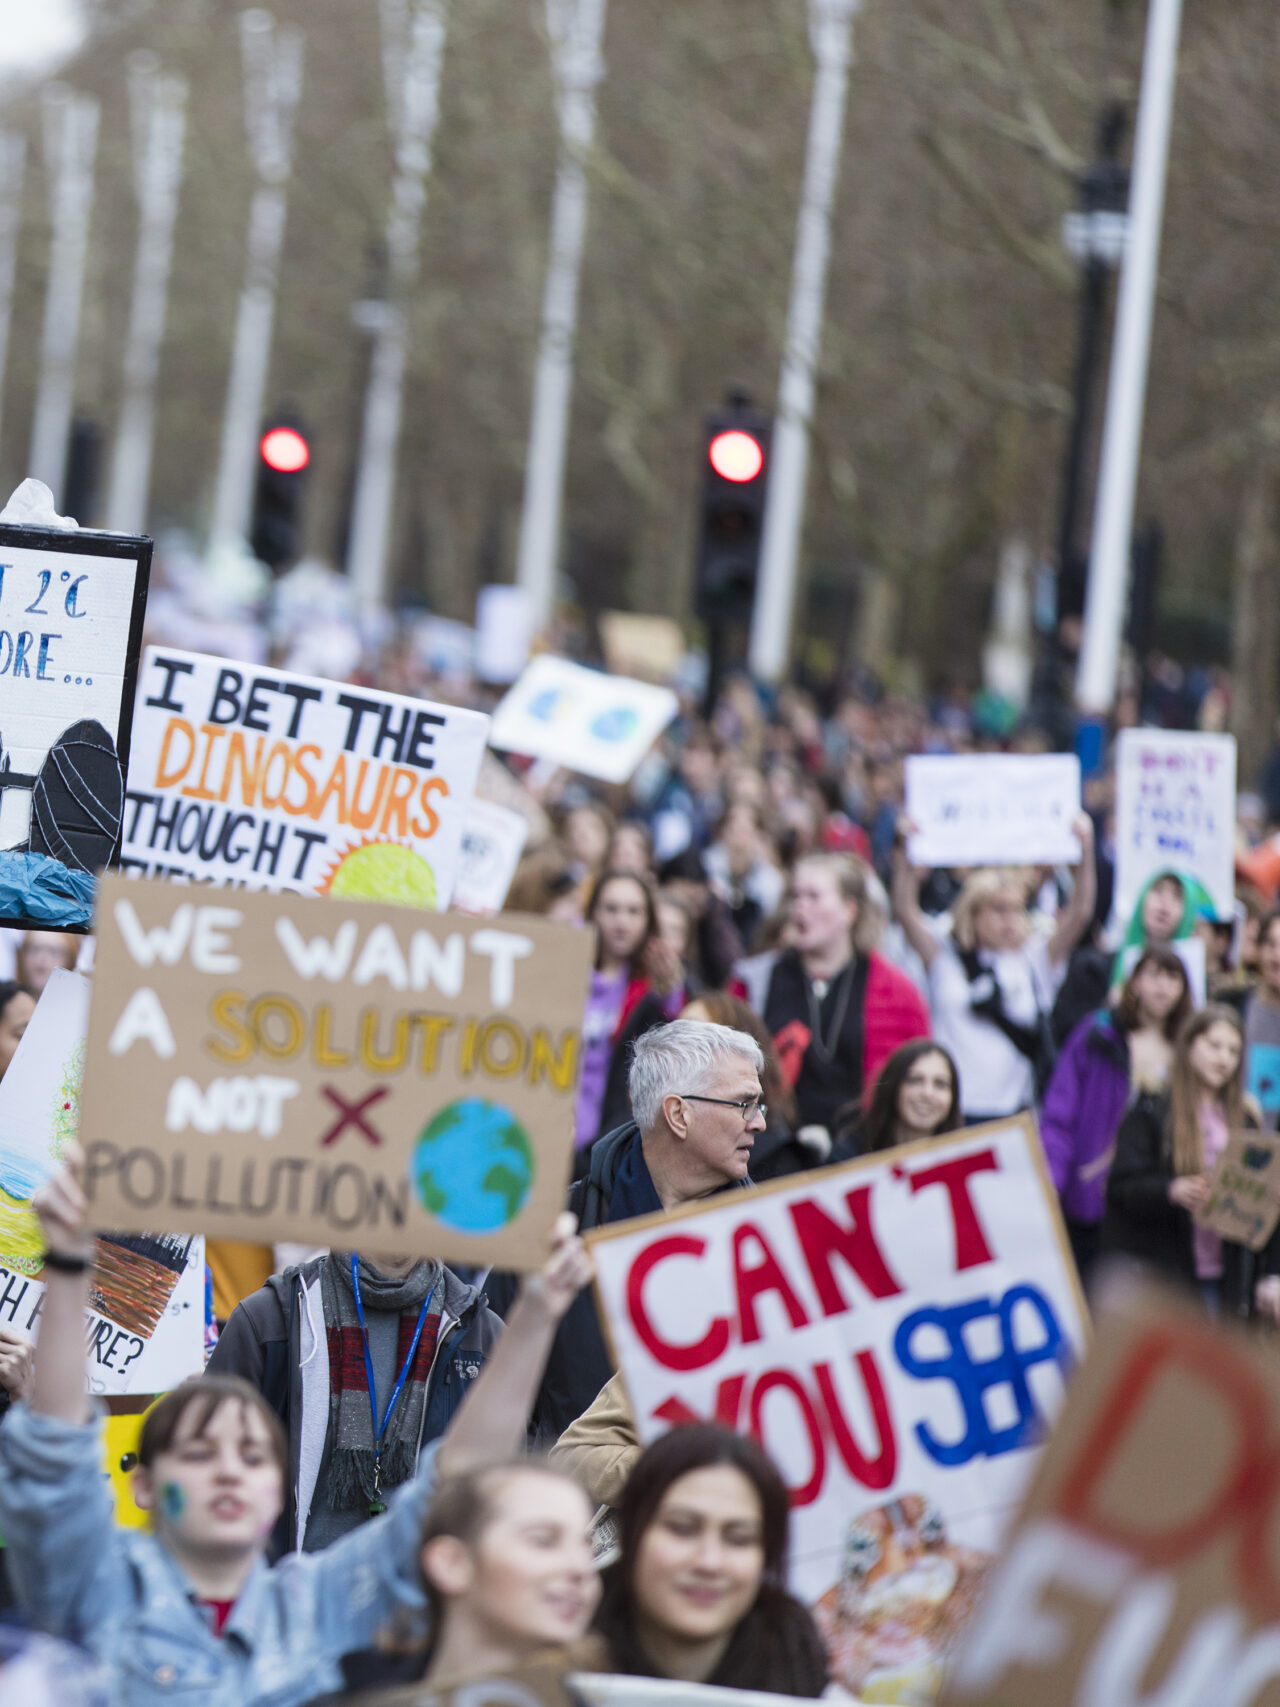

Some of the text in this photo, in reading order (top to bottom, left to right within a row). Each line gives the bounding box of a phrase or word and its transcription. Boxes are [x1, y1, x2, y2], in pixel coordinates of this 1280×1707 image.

[24, 568, 89, 619] 2°C
[145, 656, 447, 770] I BET THE
[154, 716, 450, 840] DINOSAURS
[125, 790, 327, 881] THOUGHT
[114, 897, 534, 1008] WE WANT
[108, 985, 580, 1093] A SOLUTION
[164, 1073, 302, 1140] NOT
[82, 1138, 410, 1233] POLLUTION
[625, 1147, 1002, 1373] CAN'T
